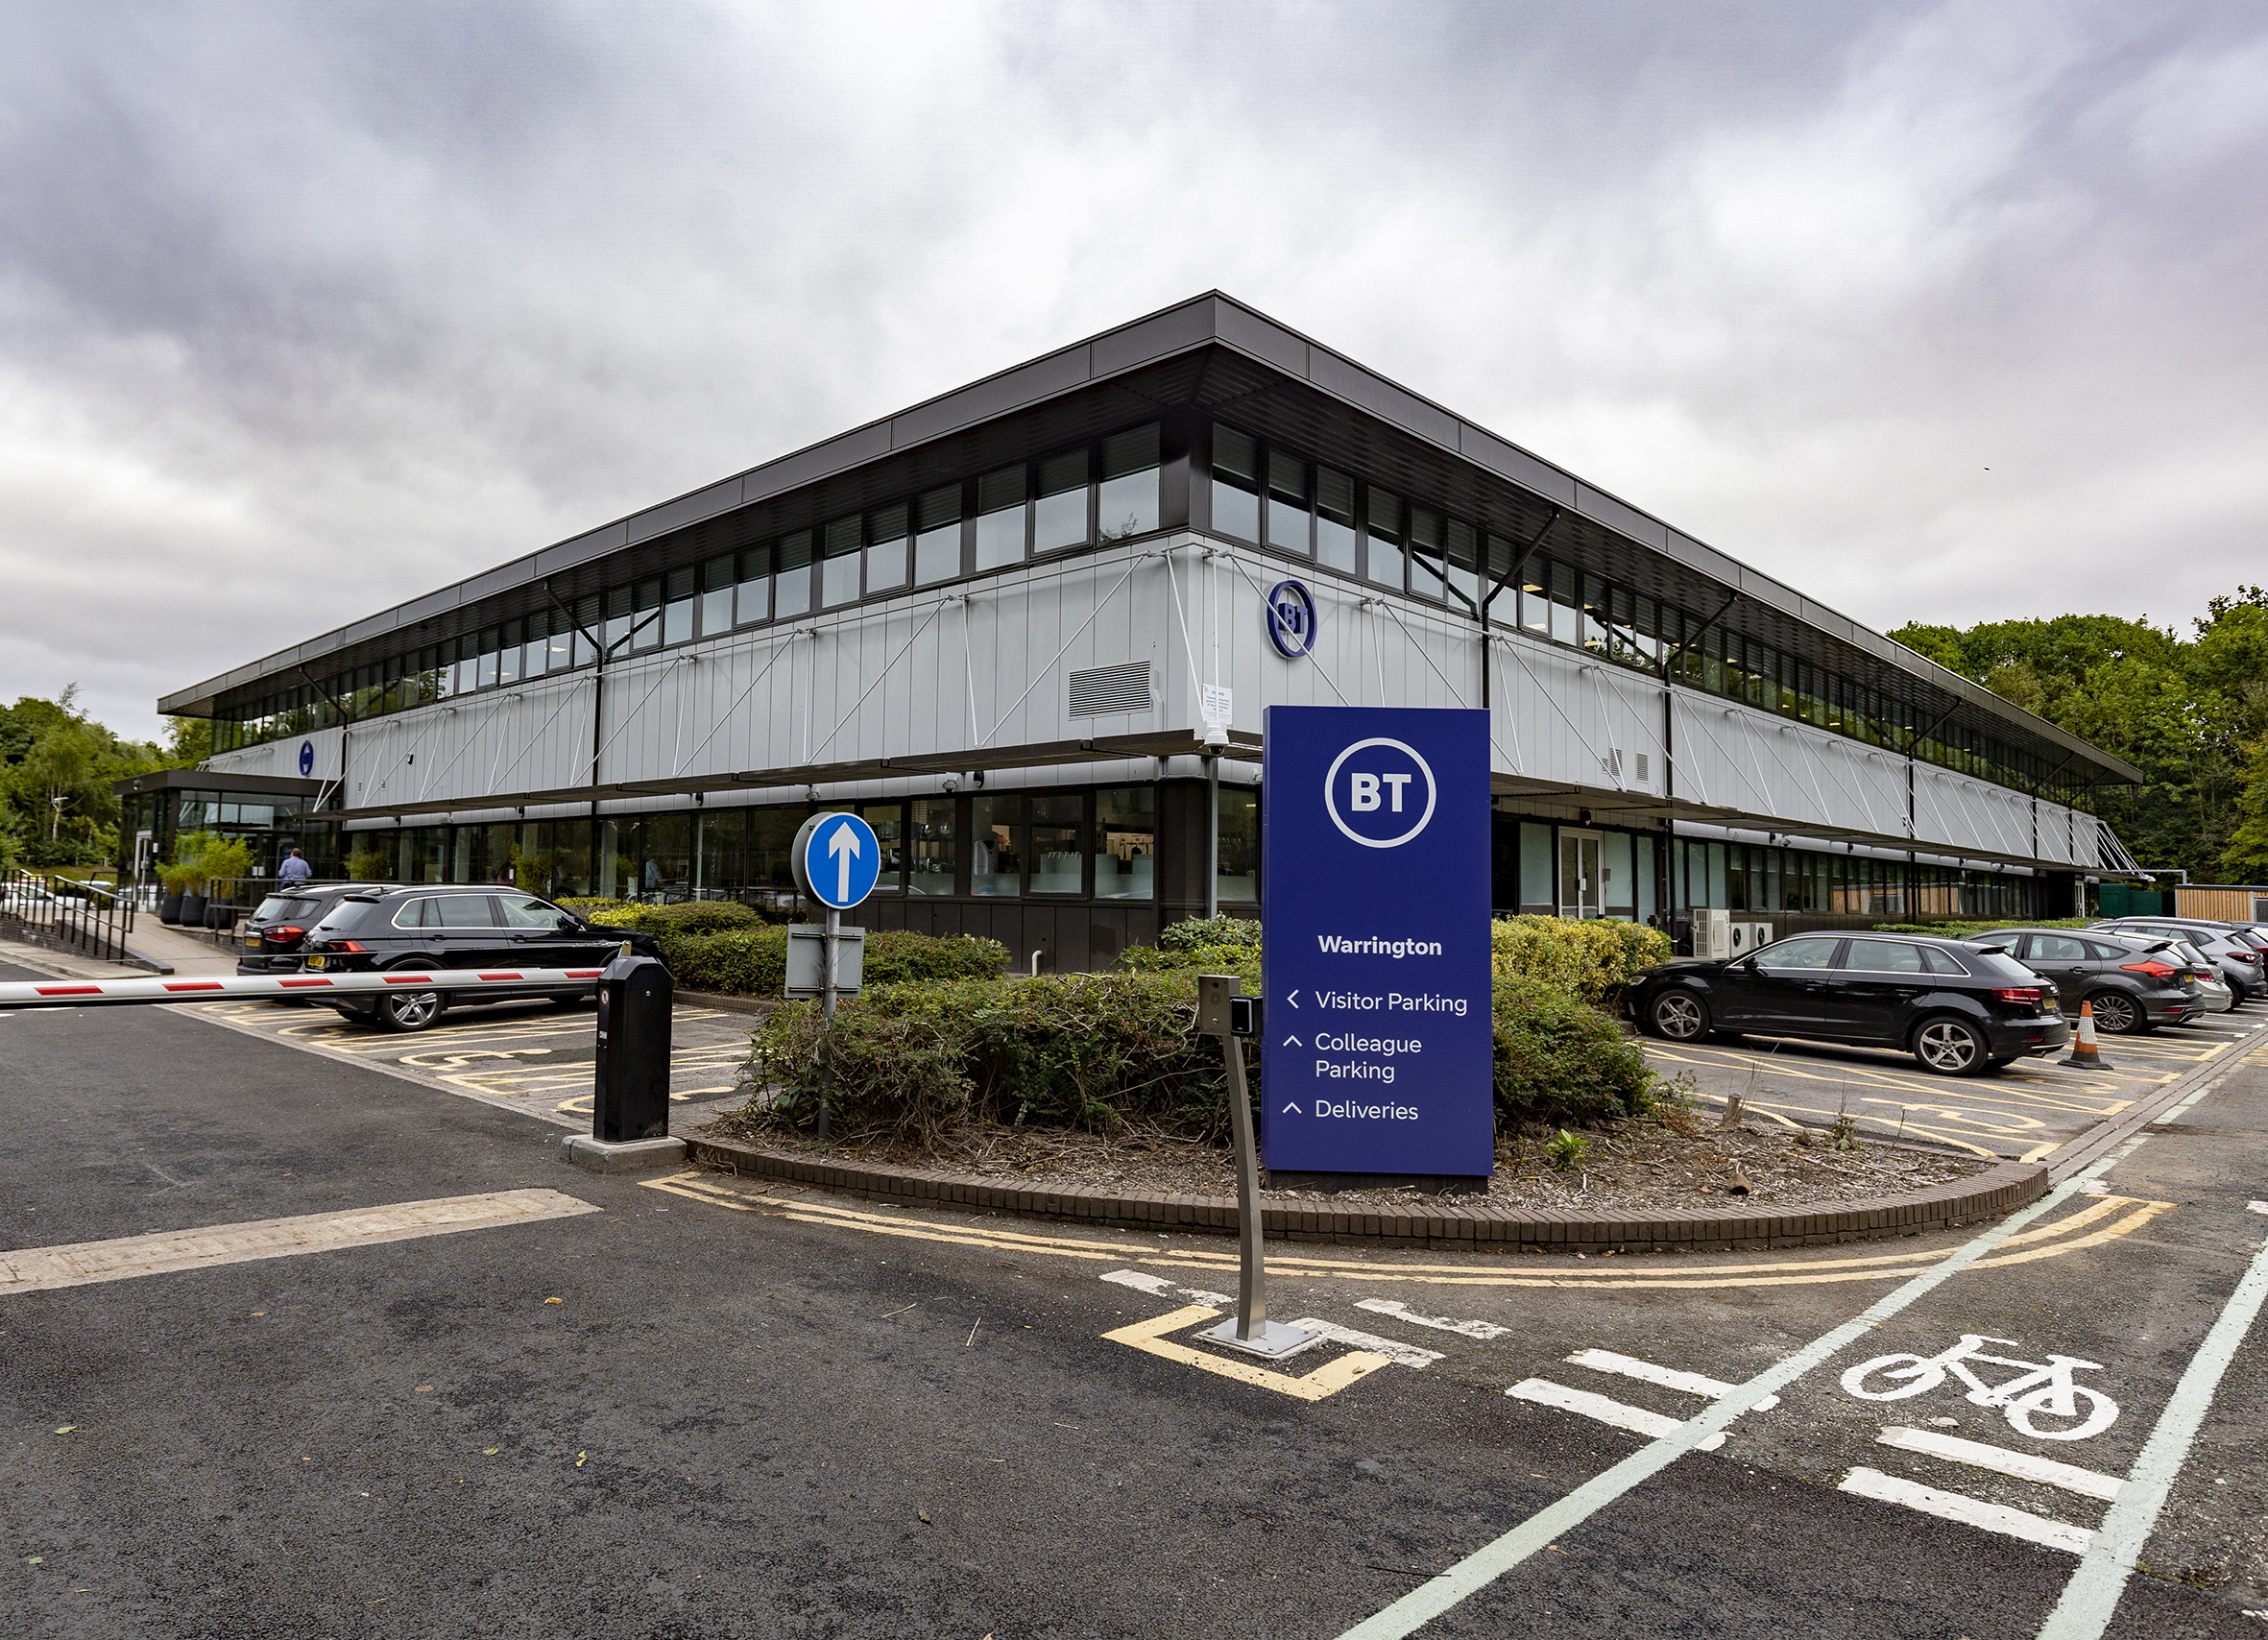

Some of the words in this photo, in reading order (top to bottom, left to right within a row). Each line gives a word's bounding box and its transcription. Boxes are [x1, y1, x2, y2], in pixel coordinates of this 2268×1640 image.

[1278, 603, 1308, 634] BT
[1352, 772, 1411, 812] BT
[1318, 935, 1442, 959] Warrington
[1315, 991, 1383, 1012] Visitor
[1387, 993, 1467, 1017] Parking
[1315, 1033, 1422, 1057] Colleague
[1316, 1060, 1395, 1084] Parking
[1316, 1100, 1419, 1121] Deliveries
